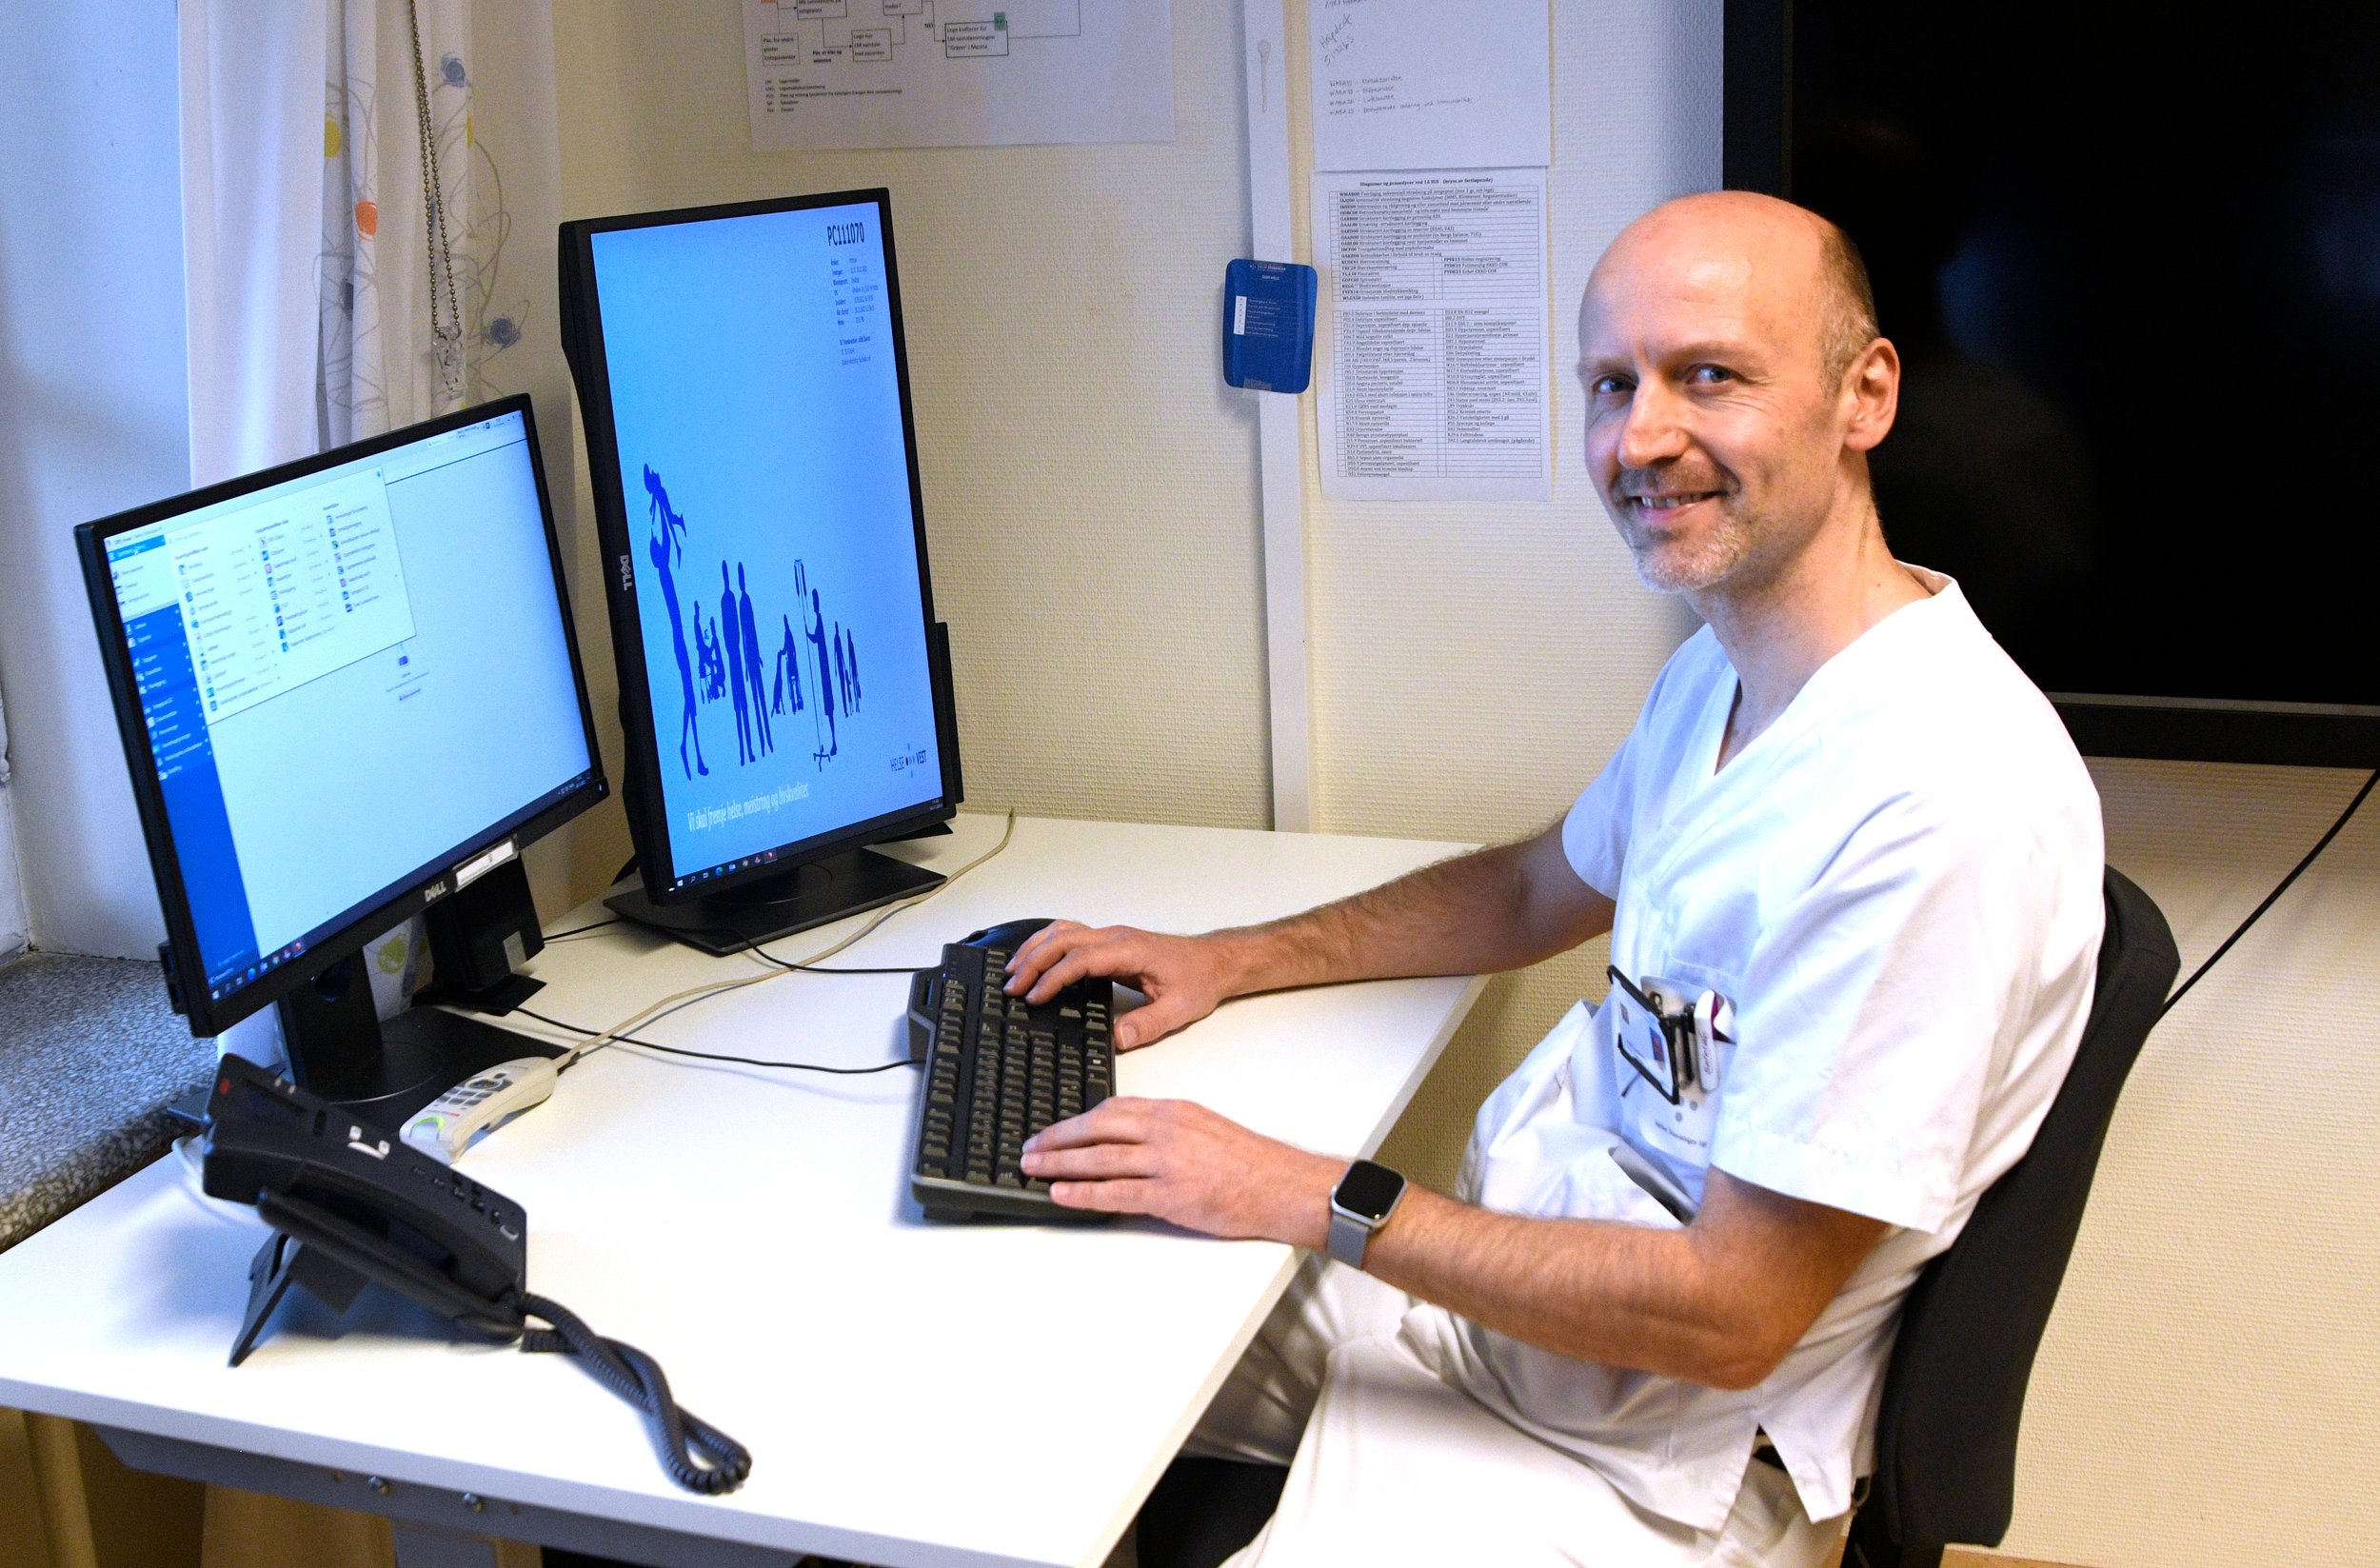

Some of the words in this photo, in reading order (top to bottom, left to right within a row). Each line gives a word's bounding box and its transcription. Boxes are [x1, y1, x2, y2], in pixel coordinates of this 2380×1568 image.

[827, 222, 865, 246] PC111070
[620, 554, 633, 591] DELL
[916, 750, 927, 765] VEST
[425, 880, 447, 902] DELL
